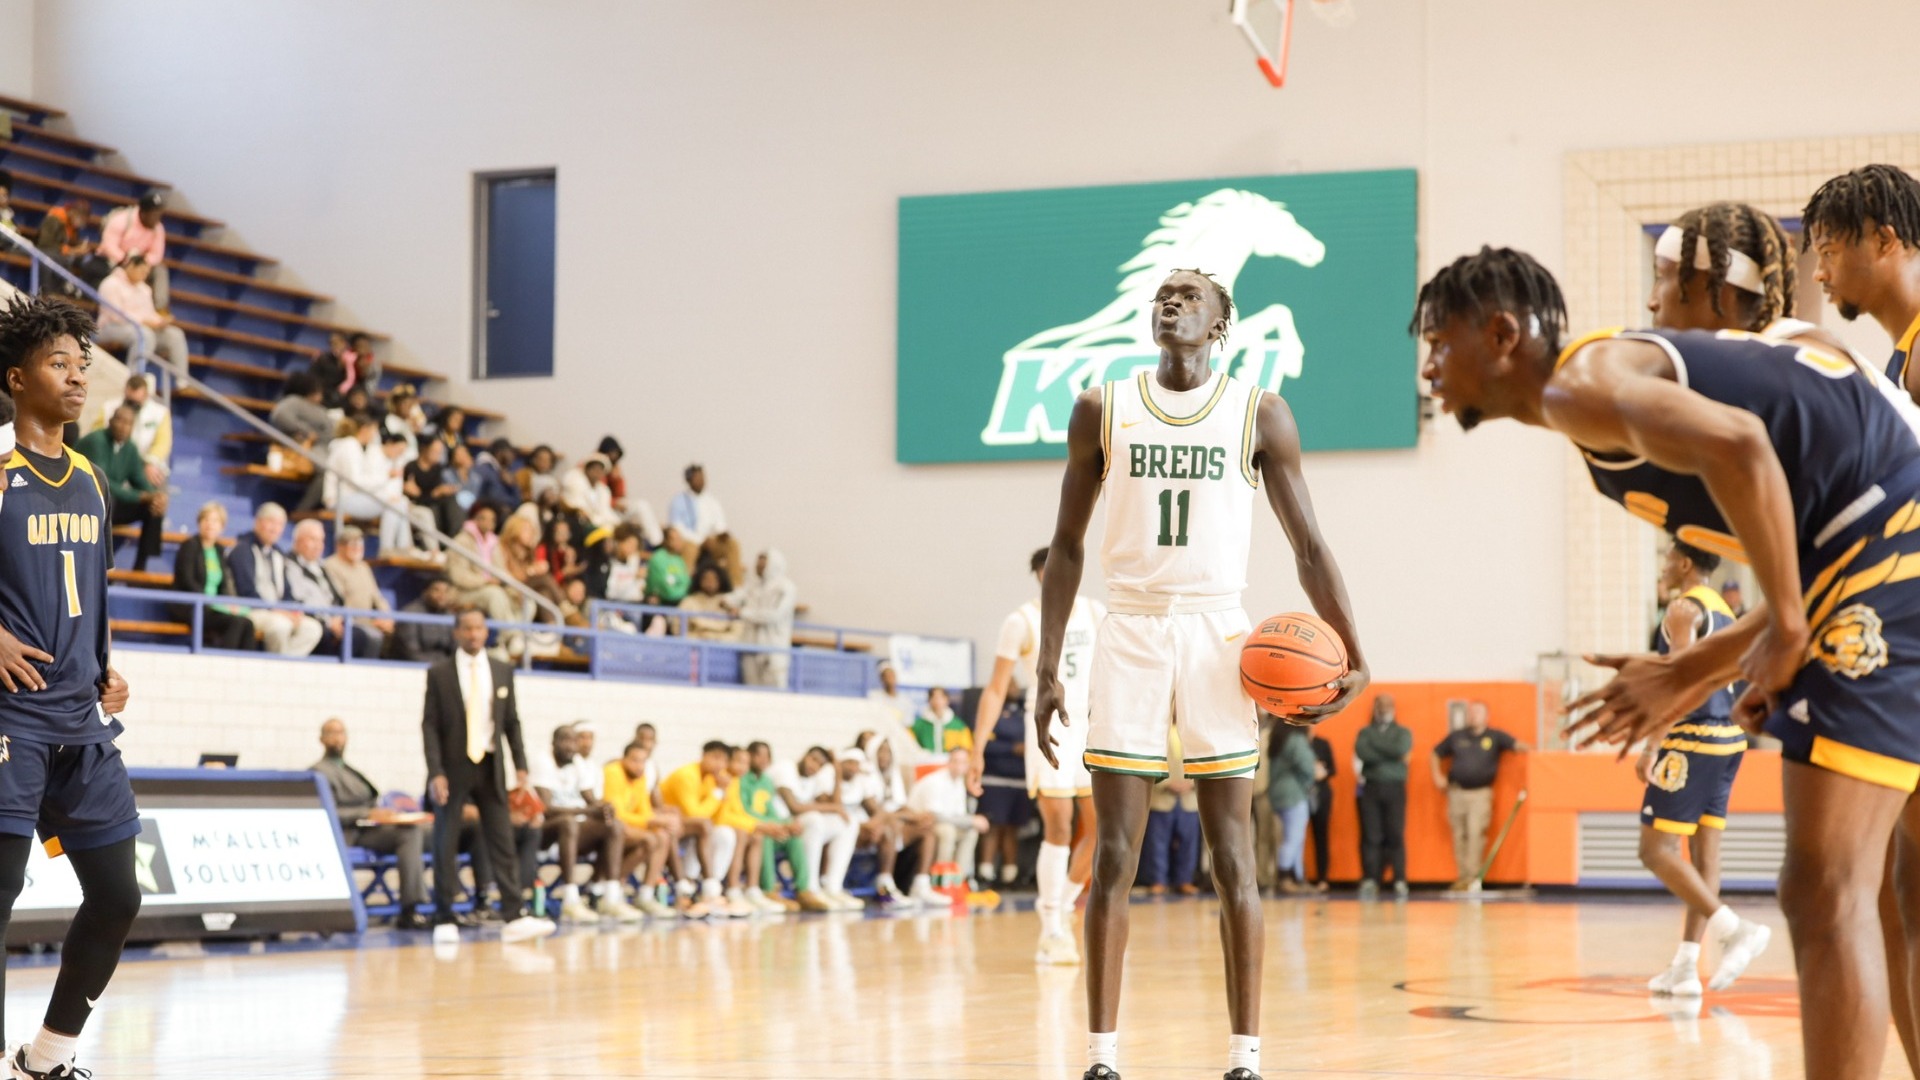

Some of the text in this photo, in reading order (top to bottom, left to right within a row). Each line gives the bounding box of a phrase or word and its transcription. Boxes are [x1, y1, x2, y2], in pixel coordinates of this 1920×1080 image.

[1129, 443, 1226, 481] BREDS
[1157, 489, 1190, 546] 11
[60, 550, 83, 618] 1
[1261, 622, 1315, 643] ELITE
[1065, 652, 1077, 679] 5
[183, 863, 326, 884] SOLUTIONS
